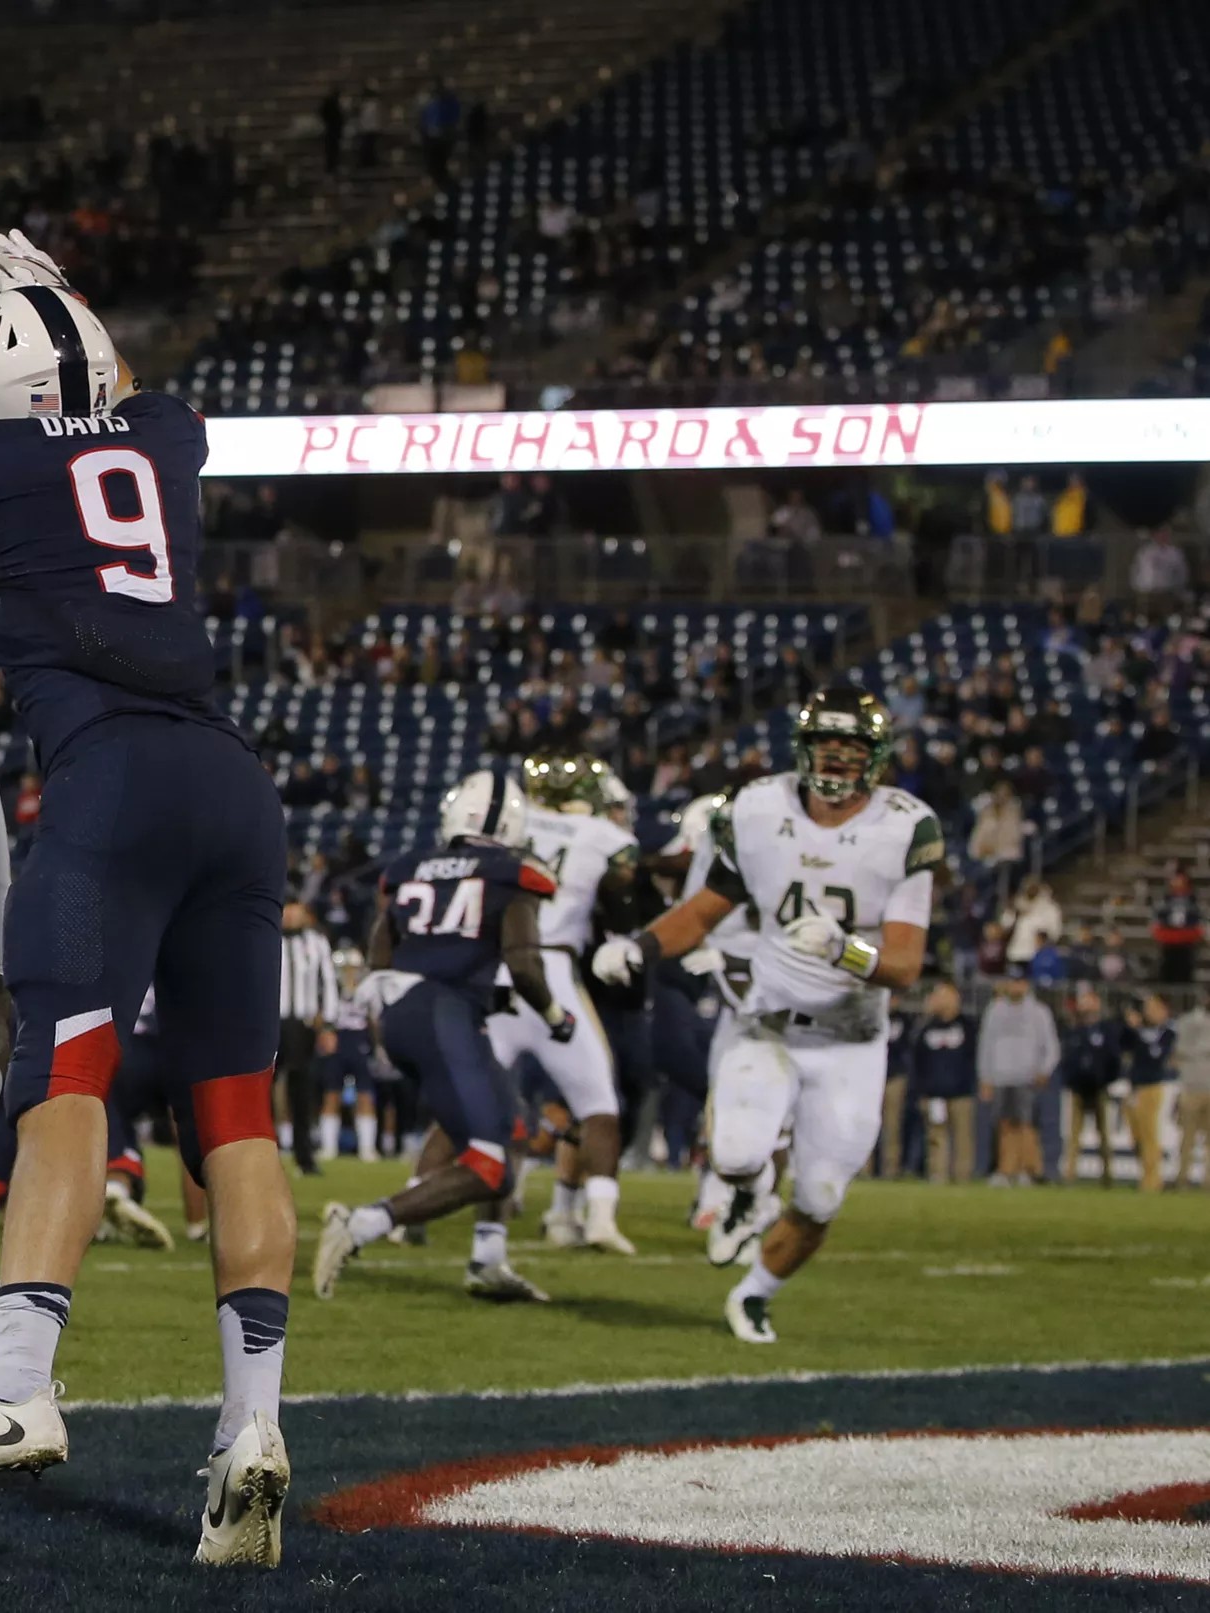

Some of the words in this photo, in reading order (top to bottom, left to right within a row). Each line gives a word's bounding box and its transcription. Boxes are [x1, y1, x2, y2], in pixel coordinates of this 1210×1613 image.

[401, 419, 710, 464] RICHARD
[788, 413, 925, 457] SON
[66, 446, 177, 603] 9
